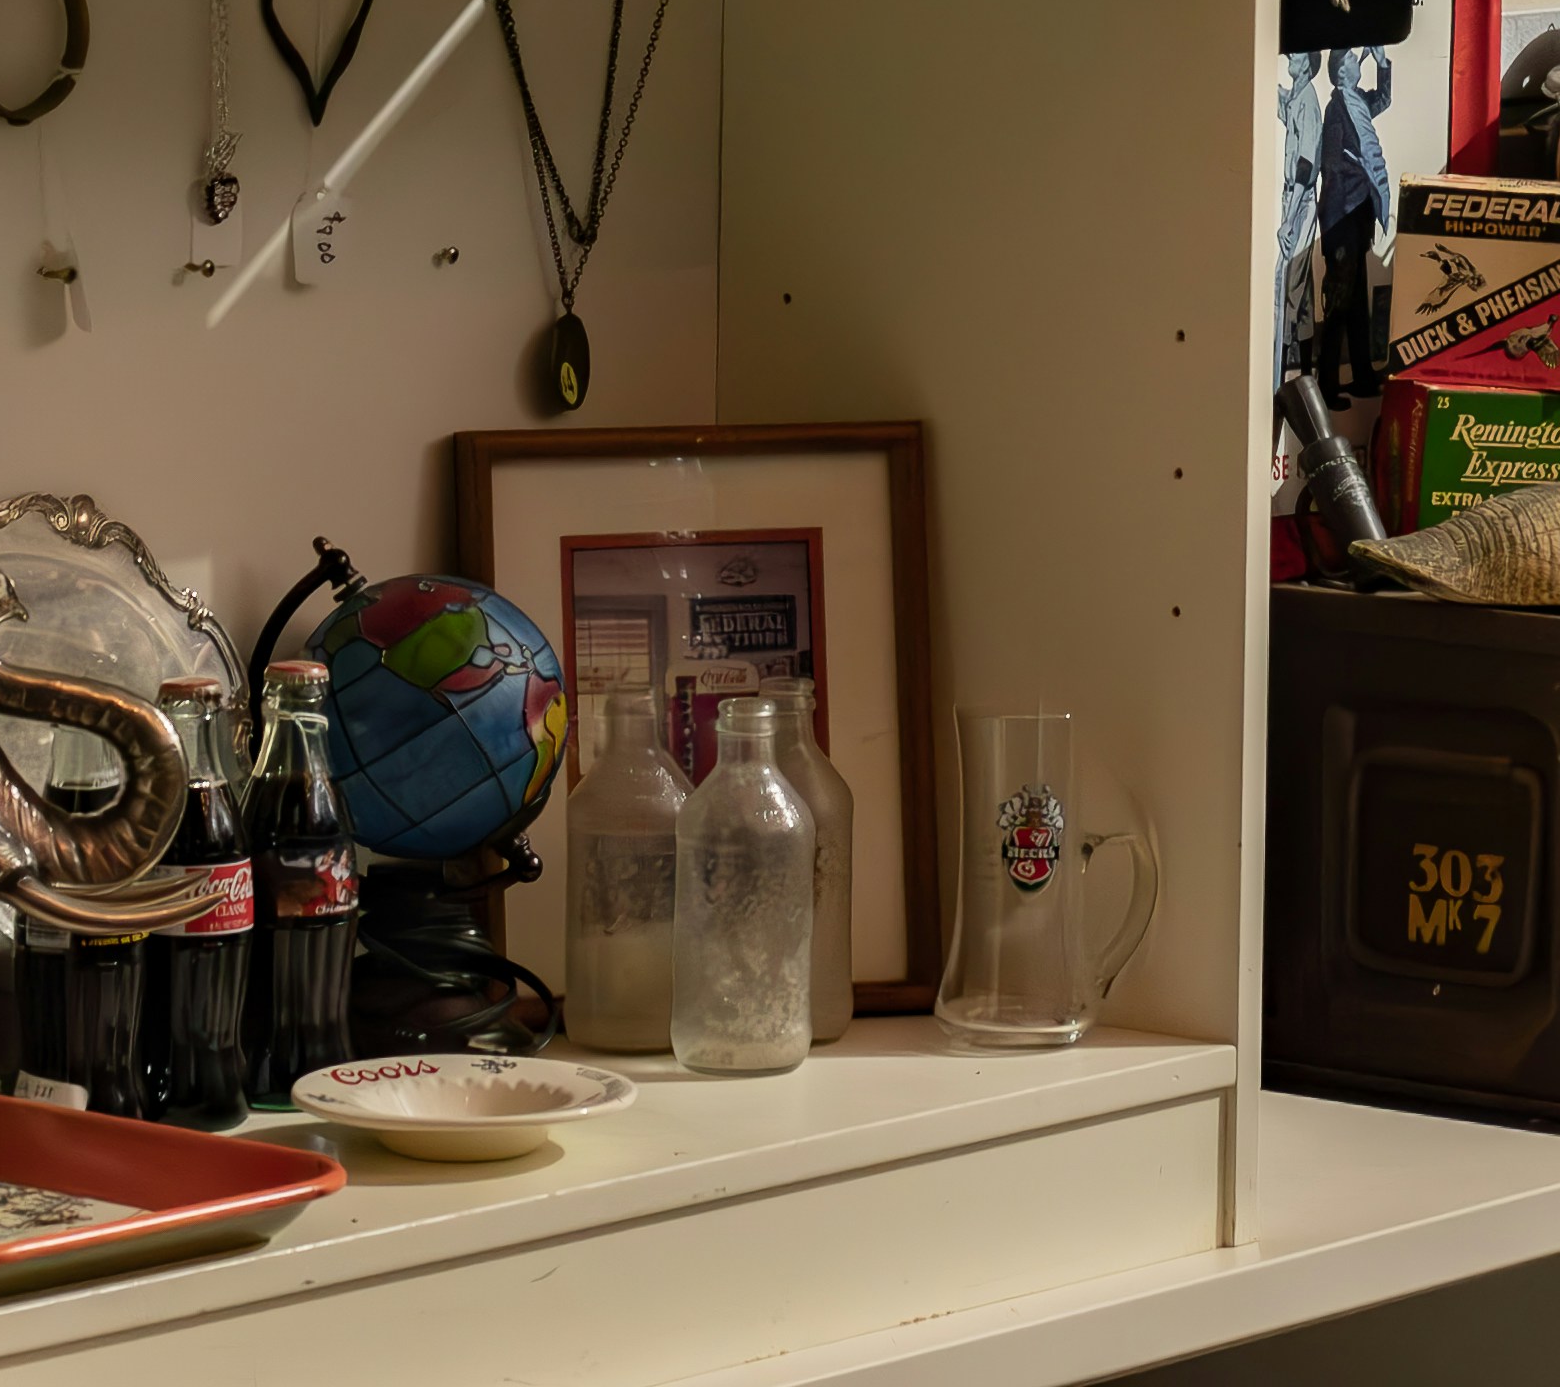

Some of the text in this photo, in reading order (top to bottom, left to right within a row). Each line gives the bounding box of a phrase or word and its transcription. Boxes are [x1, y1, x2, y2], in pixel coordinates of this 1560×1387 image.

[1395, 322, 1457, 368] DUCK
[1457, 309, 1478, 335] &
[1436, 395, 1451, 410] 25
[1430, 490, 1484, 508] EXTRA
[1407, 842, 1506, 906] 303
[1472, 903, 1502, 957] 7
[329, 1057, 442, 1088] Coors
